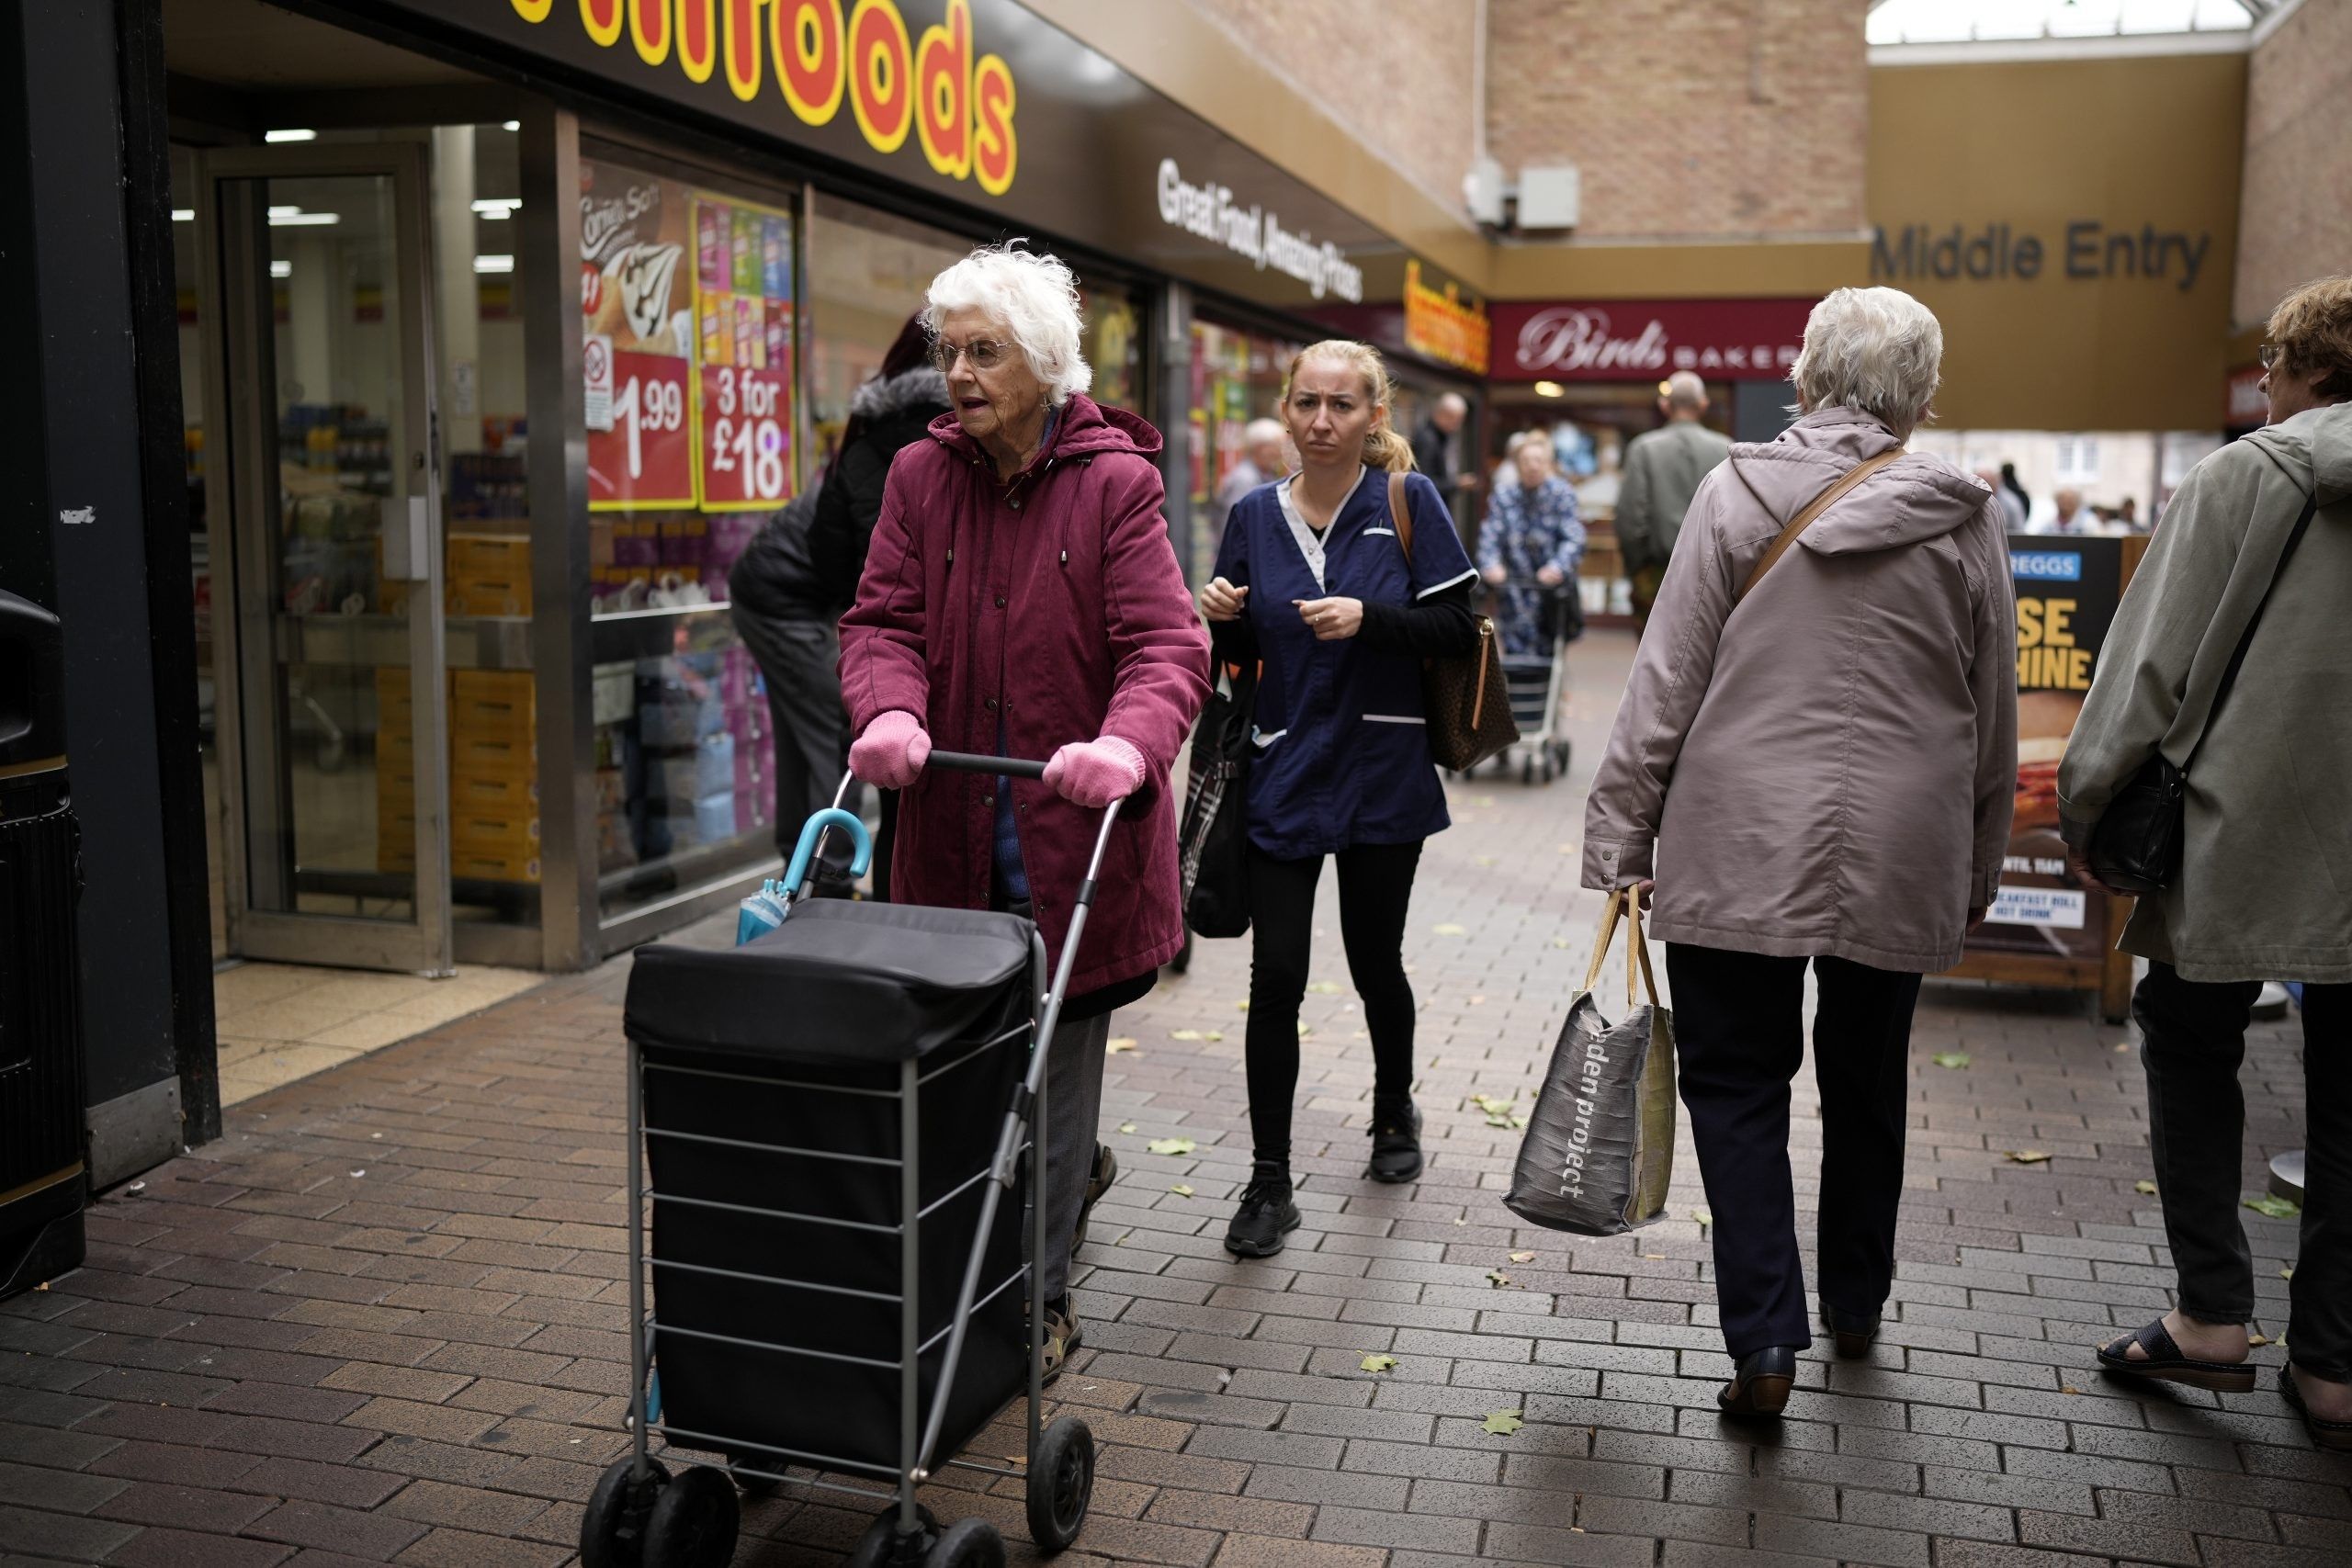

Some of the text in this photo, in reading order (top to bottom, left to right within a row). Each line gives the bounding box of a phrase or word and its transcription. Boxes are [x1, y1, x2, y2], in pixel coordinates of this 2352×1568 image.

[1158, 157, 1216, 242] Great
[1869, 220, 2211, 292] Middle Entry
[1516, 307, 1803, 372] Birds BAKER
[717, 367, 781, 418] 3 for
[712, 419, 784, 501] £18
[2010, 554, 2075, 577] REGGS
[2017, 596, 2076, 648] SE
[2016, 646, 2092, 690] HINE
[1560, 1098, 1592, 1199] project
